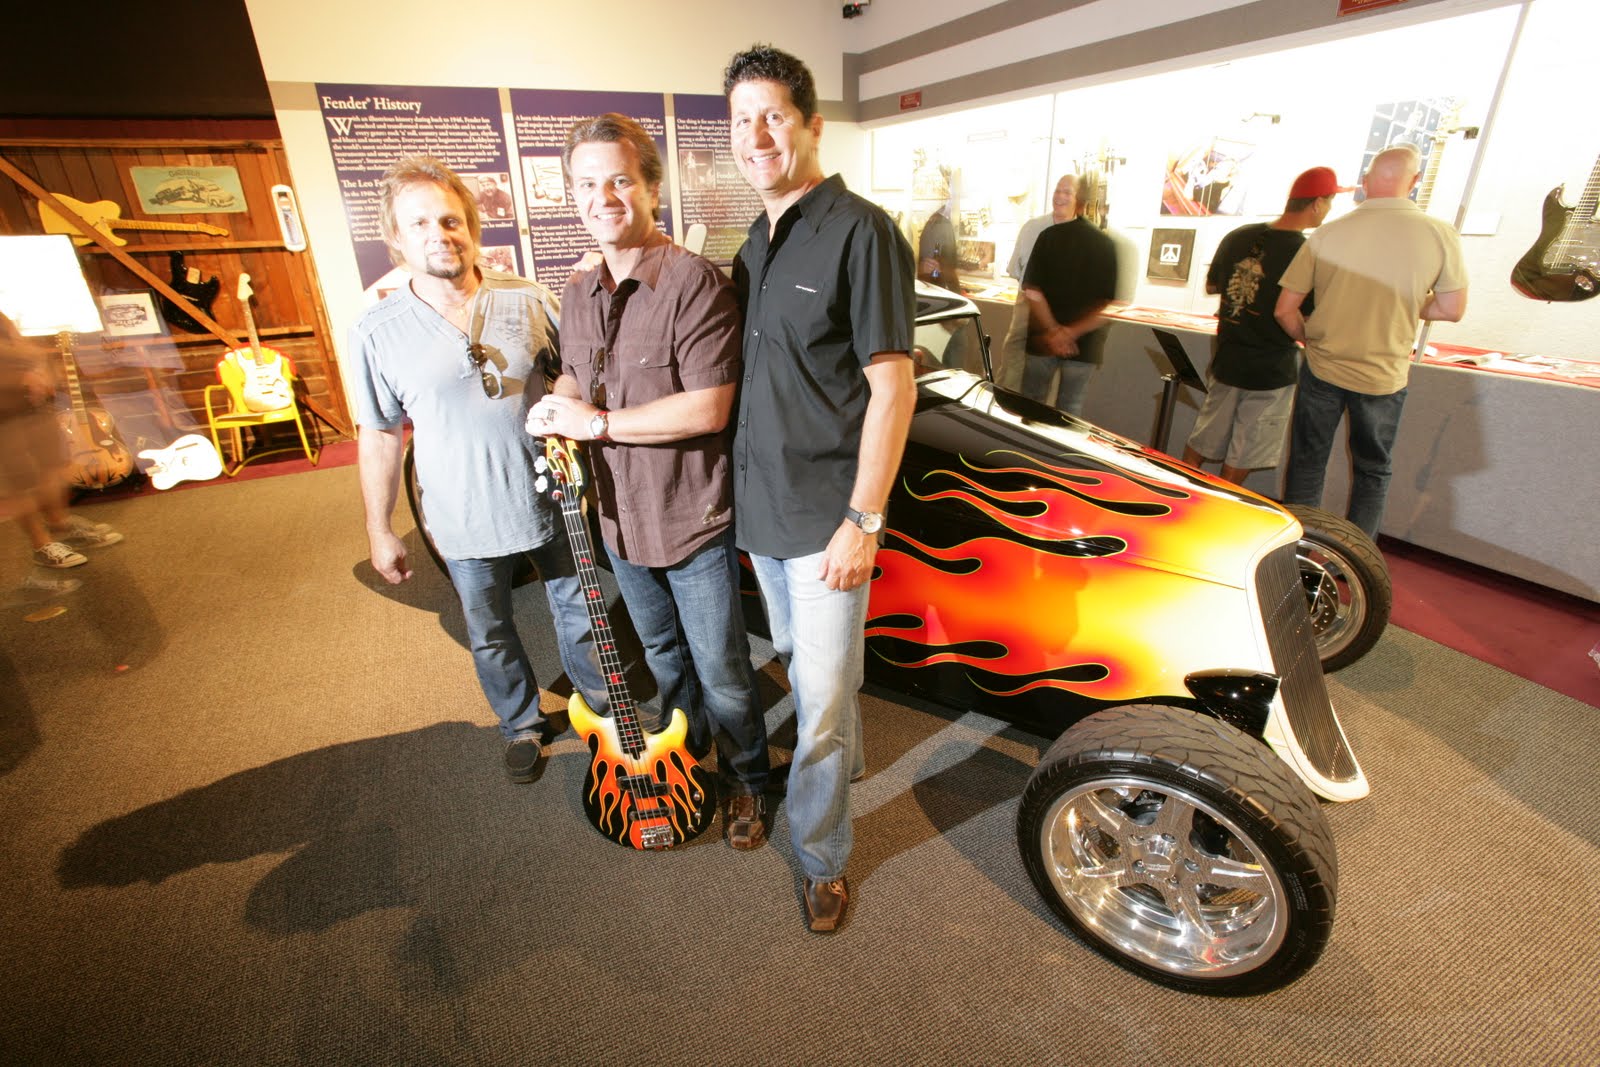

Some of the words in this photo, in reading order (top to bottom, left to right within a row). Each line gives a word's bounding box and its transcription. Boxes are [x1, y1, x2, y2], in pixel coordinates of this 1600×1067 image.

[373, 97, 422, 113] History
[395, 116, 414, 124] history
[341, 180, 357, 188] The
[358, 180, 373, 188] Leo
